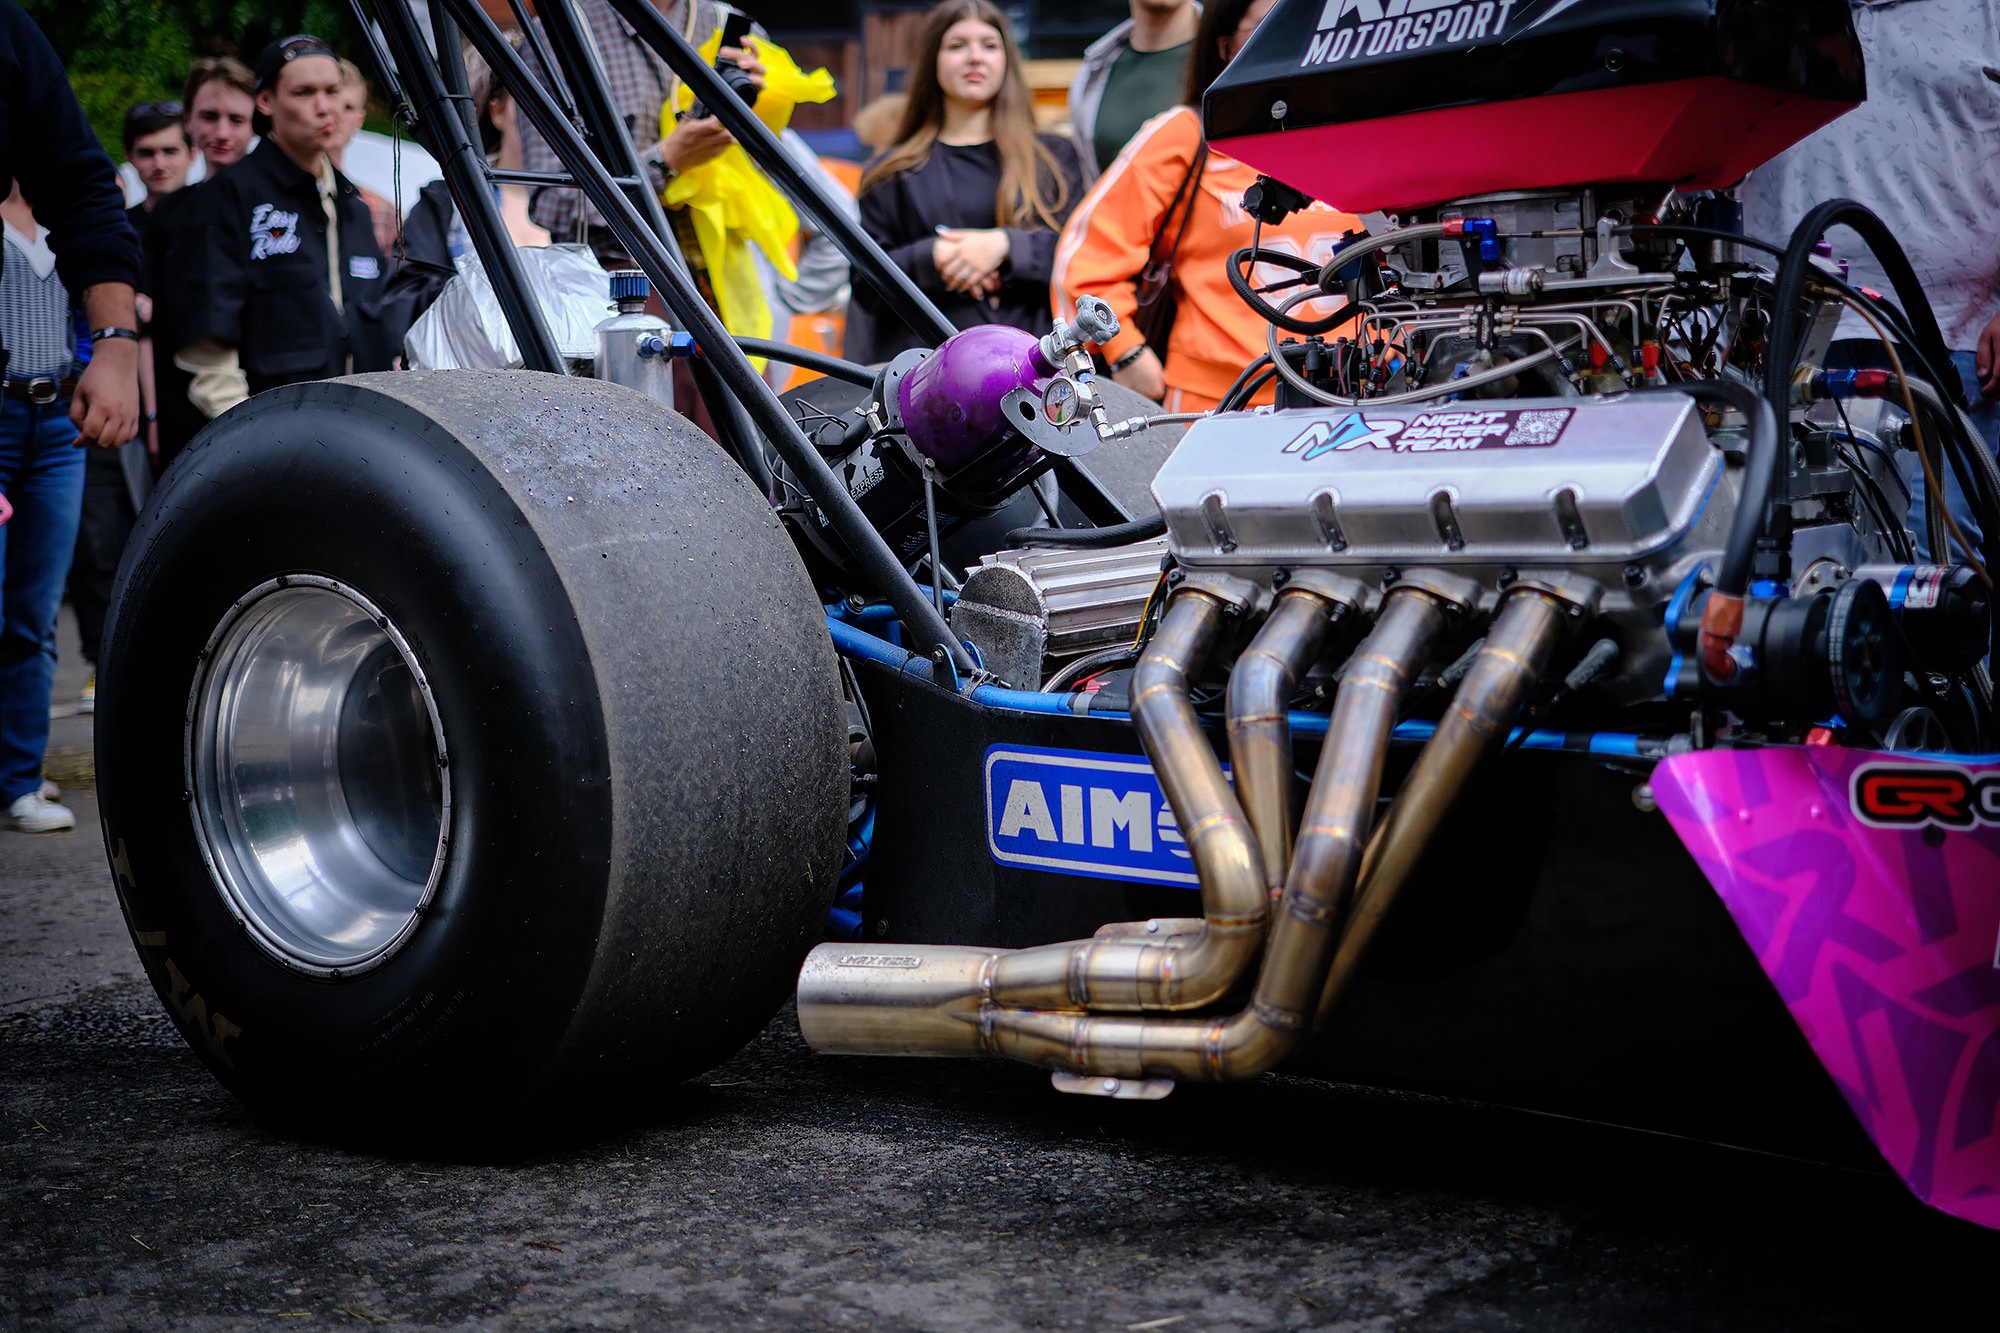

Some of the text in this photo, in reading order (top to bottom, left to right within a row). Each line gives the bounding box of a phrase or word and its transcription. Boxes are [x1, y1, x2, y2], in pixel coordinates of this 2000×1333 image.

[1301, 1, 1516, 67] MOTORSPORT
[1414, 412, 1507, 426] NIGHT
[1401, 424, 1510, 439] RACER
[1396, 437, 1482, 451] TEAM
[850, 466, 885, 498] EXPRESS
[999, 779, 1191, 858] AIM
